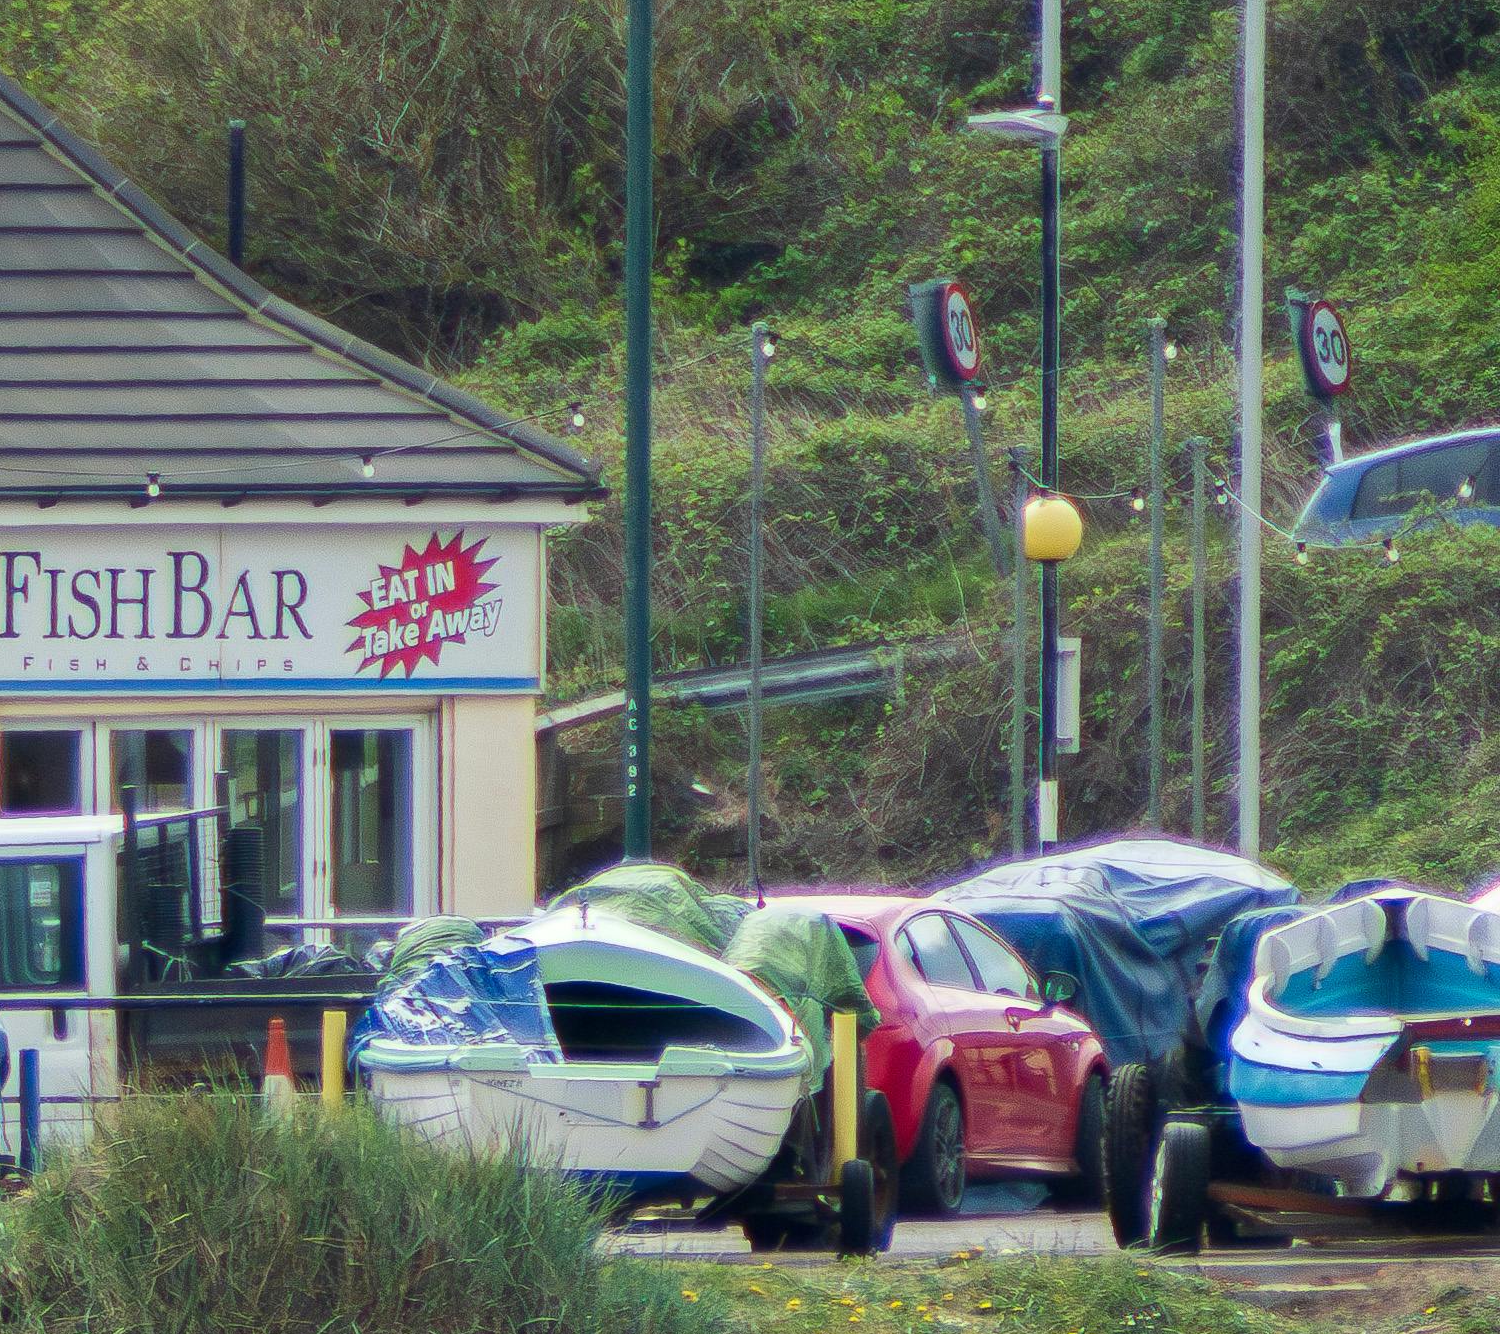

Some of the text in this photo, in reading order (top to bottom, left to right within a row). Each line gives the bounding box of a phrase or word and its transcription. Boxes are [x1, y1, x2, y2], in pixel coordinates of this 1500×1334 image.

[950, 310, 974, 352] 30
[1315, 326, 1346, 366] 30
[165, 550, 314, 640] BAR
[370, 560, 456, 611] EAT IN
[361, 599, 503, 659] Take Away
[410, 601, 429, 620] or
[22, 656, 294, 672] FISH & CHIPS
